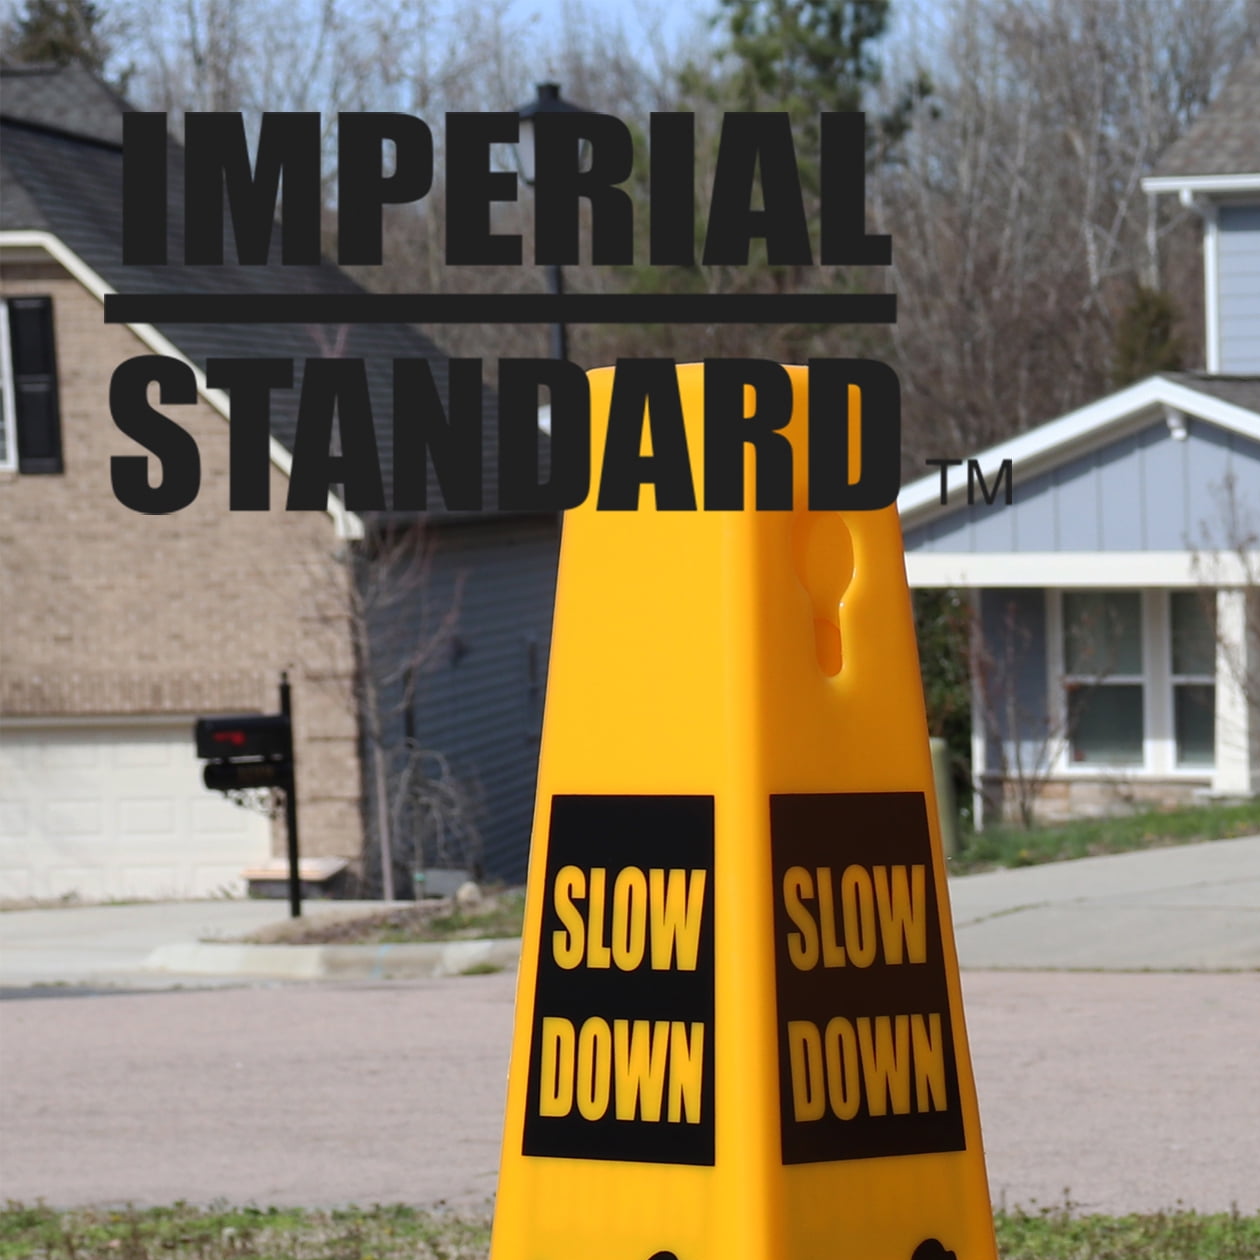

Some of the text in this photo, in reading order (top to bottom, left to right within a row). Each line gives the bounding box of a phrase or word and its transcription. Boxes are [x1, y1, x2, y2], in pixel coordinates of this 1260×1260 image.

[552, 865, 706, 972] SLOW
[783, 864, 926, 972] SLOW
[539, 1016, 704, 1124] DOWN
[787, 1013, 948, 1122] DOWN
